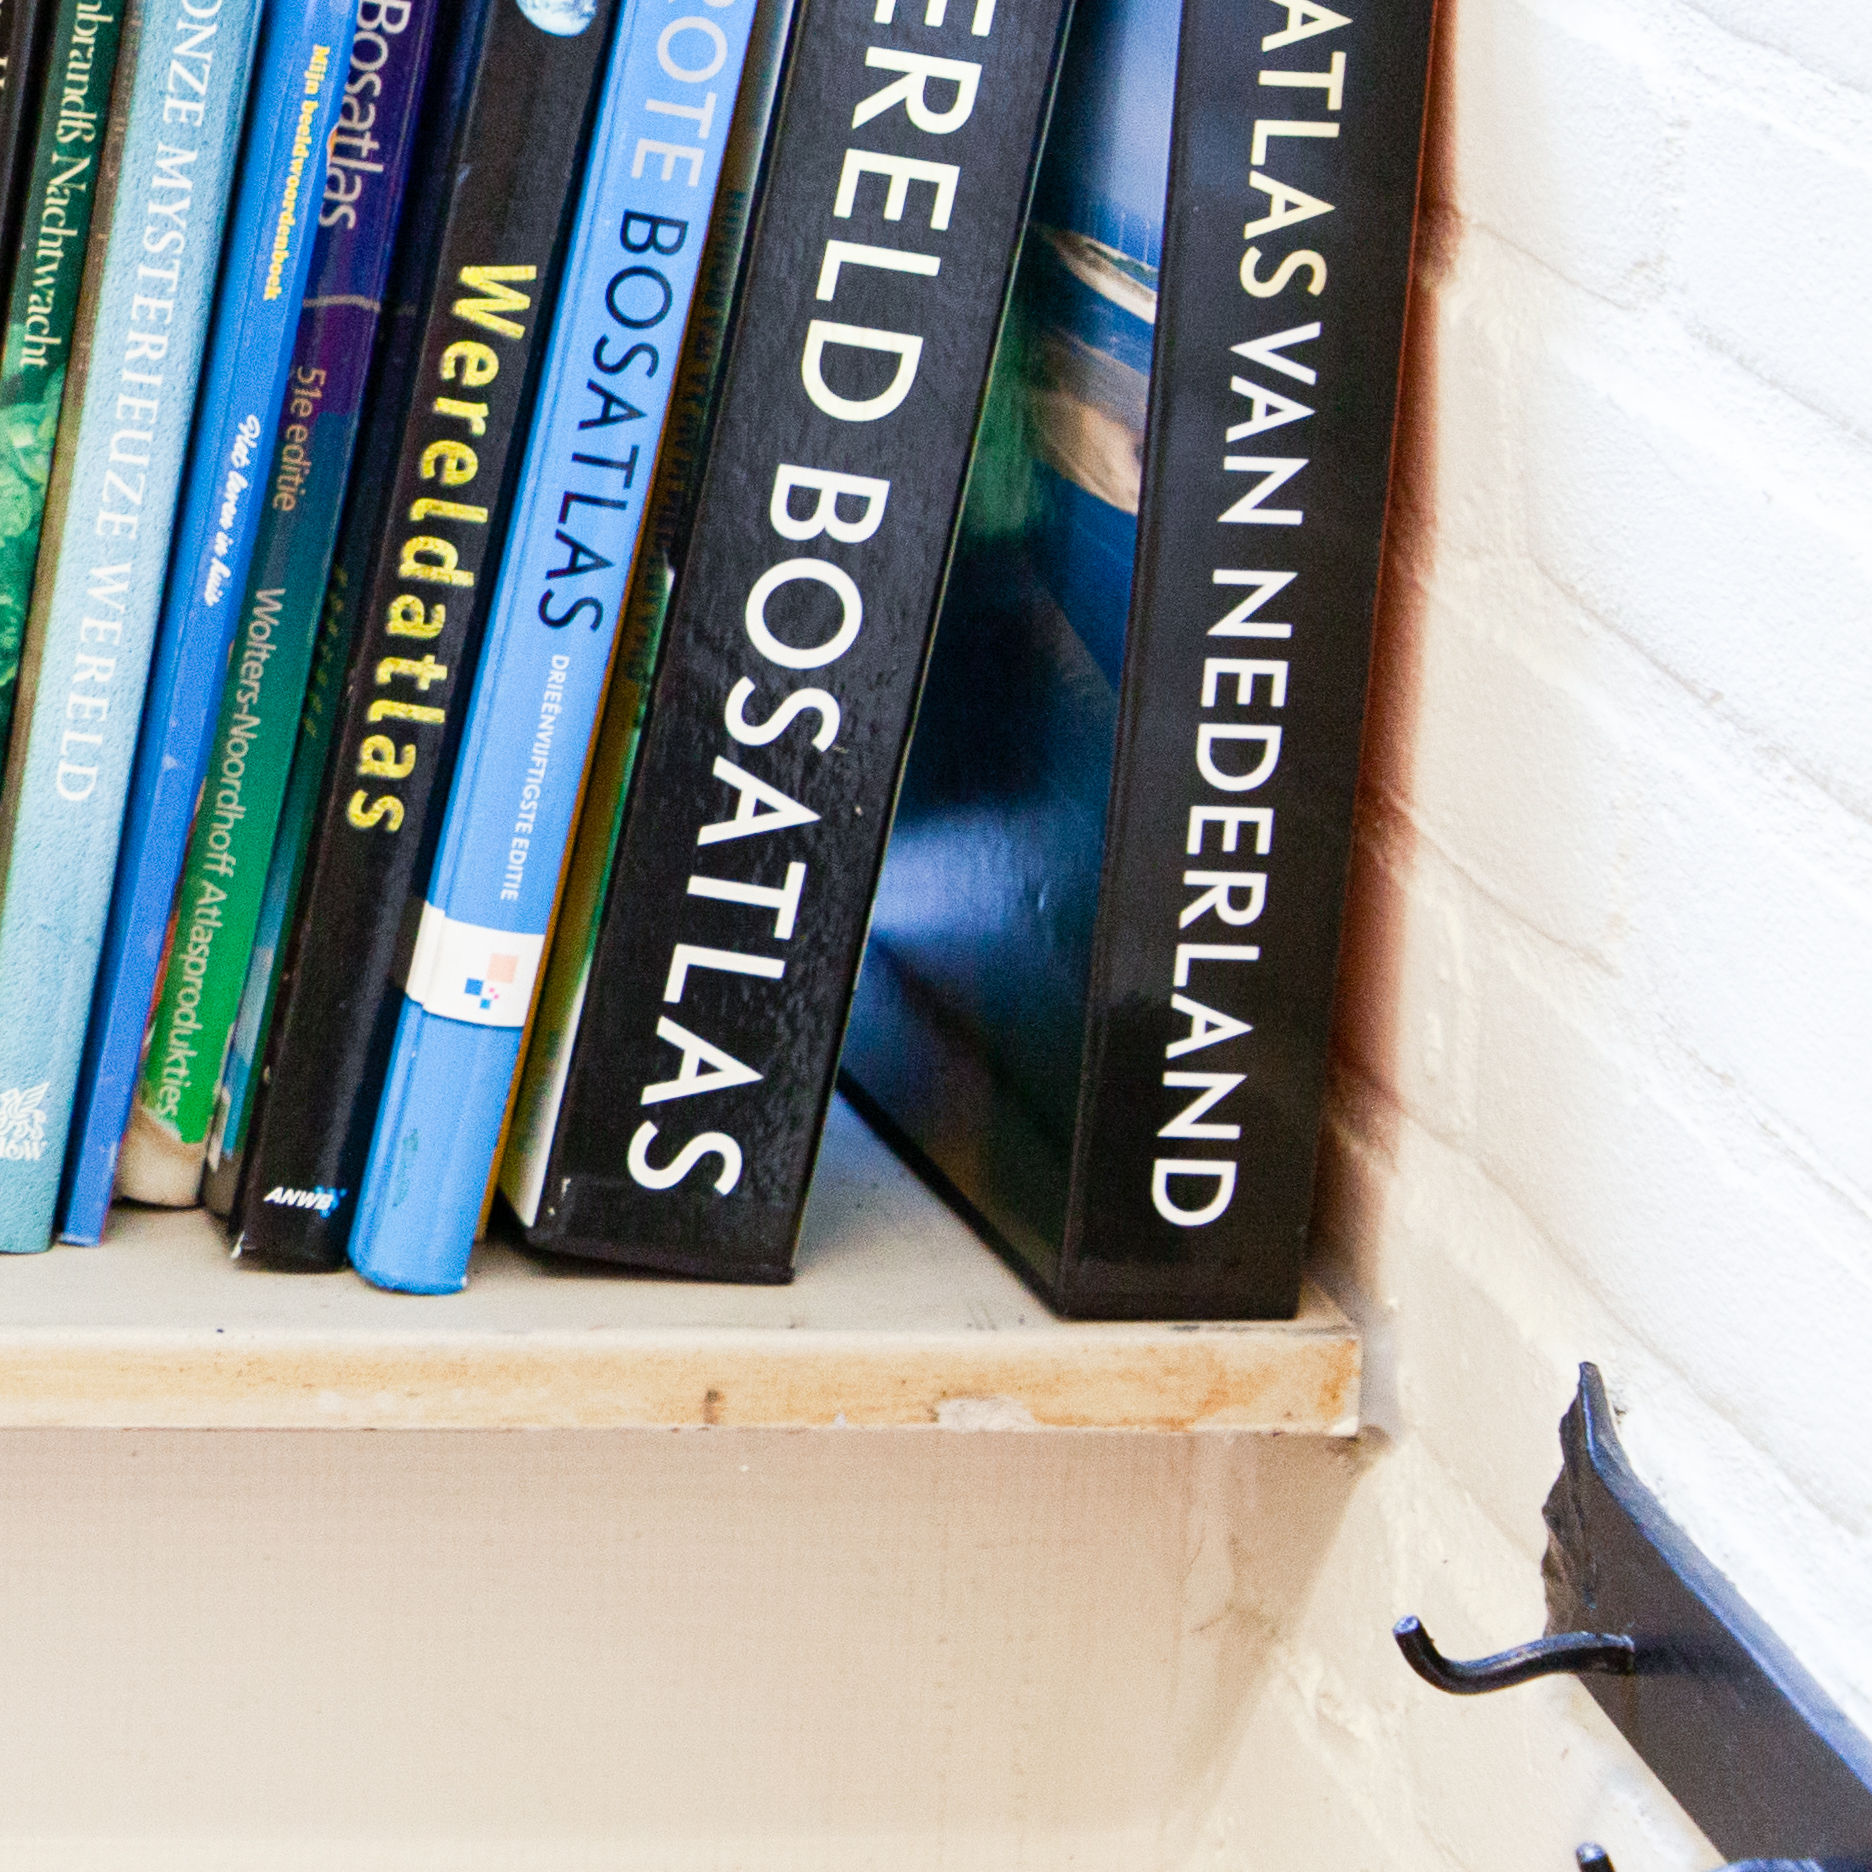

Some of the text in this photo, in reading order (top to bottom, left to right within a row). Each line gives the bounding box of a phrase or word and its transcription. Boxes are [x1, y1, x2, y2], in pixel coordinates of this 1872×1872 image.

[20, 153, 92, 369] Nachtwacht
[95, 142, 199, 538] MYSTERIEUZE
[273, 366, 327, 512] 51e editie
[346, 263, 538, 834] Wereldatlas
[536, 210, 691, 634] BOSATLAS
[1215, 321, 1322, 526] VAN
[57, 562, 133, 803] WERELD
[624, 463, 891, 1196] BOSATLAS
[157, 587, 286, 1117] Wolters-Noordhoff Atlasprodukties
[500, 836, 530, 902] EDITIE
[1149, 567, 1299, 1226] NEDERLAND
[263, 1186, 334, 1210] ANWB
